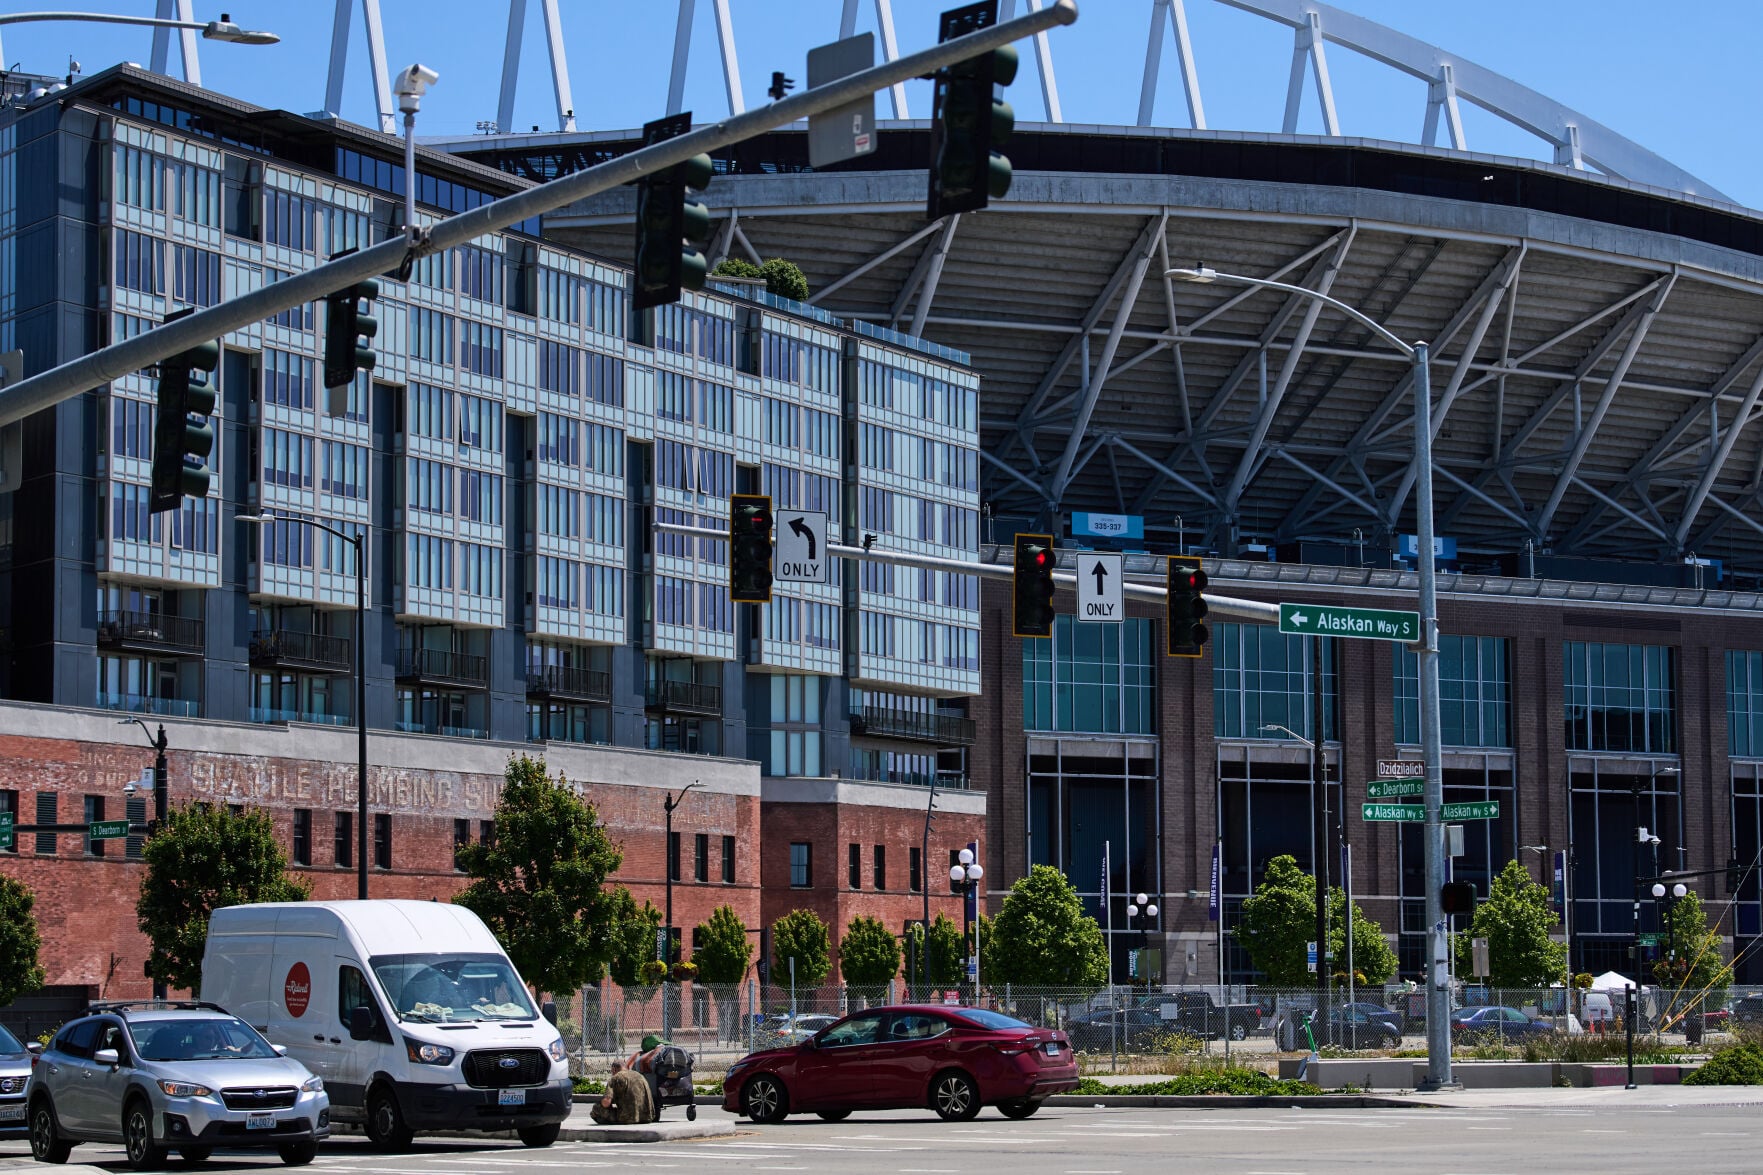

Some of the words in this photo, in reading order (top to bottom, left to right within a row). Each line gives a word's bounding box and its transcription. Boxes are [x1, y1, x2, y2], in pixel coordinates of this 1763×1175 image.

[1094, 522, 1122, 531] 335-337
[782, 562, 819, 577] ONLY
[1086, 603, 1114, 616] ONLY
[1317, 612, 1373, 632] Alaskan
[1377, 620, 1399, 637] Way
[1402, 621, 1410, 634] S
[1380, 762, 1423, 775] Dzidzilalich
[1383, 782, 1415, 796] Dearborn
[1375, 806, 1405, 818] Alaskan
[1407, 810, 1416, 820] Wy
[1419, 810, 1424, 818] S
[1443, 804, 1471, 817] Alaskan
[1473, 808, 1481, 818] Wy
[1484, 806, 1489, 815] S
[98, 825, 120, 834] Dearborn
